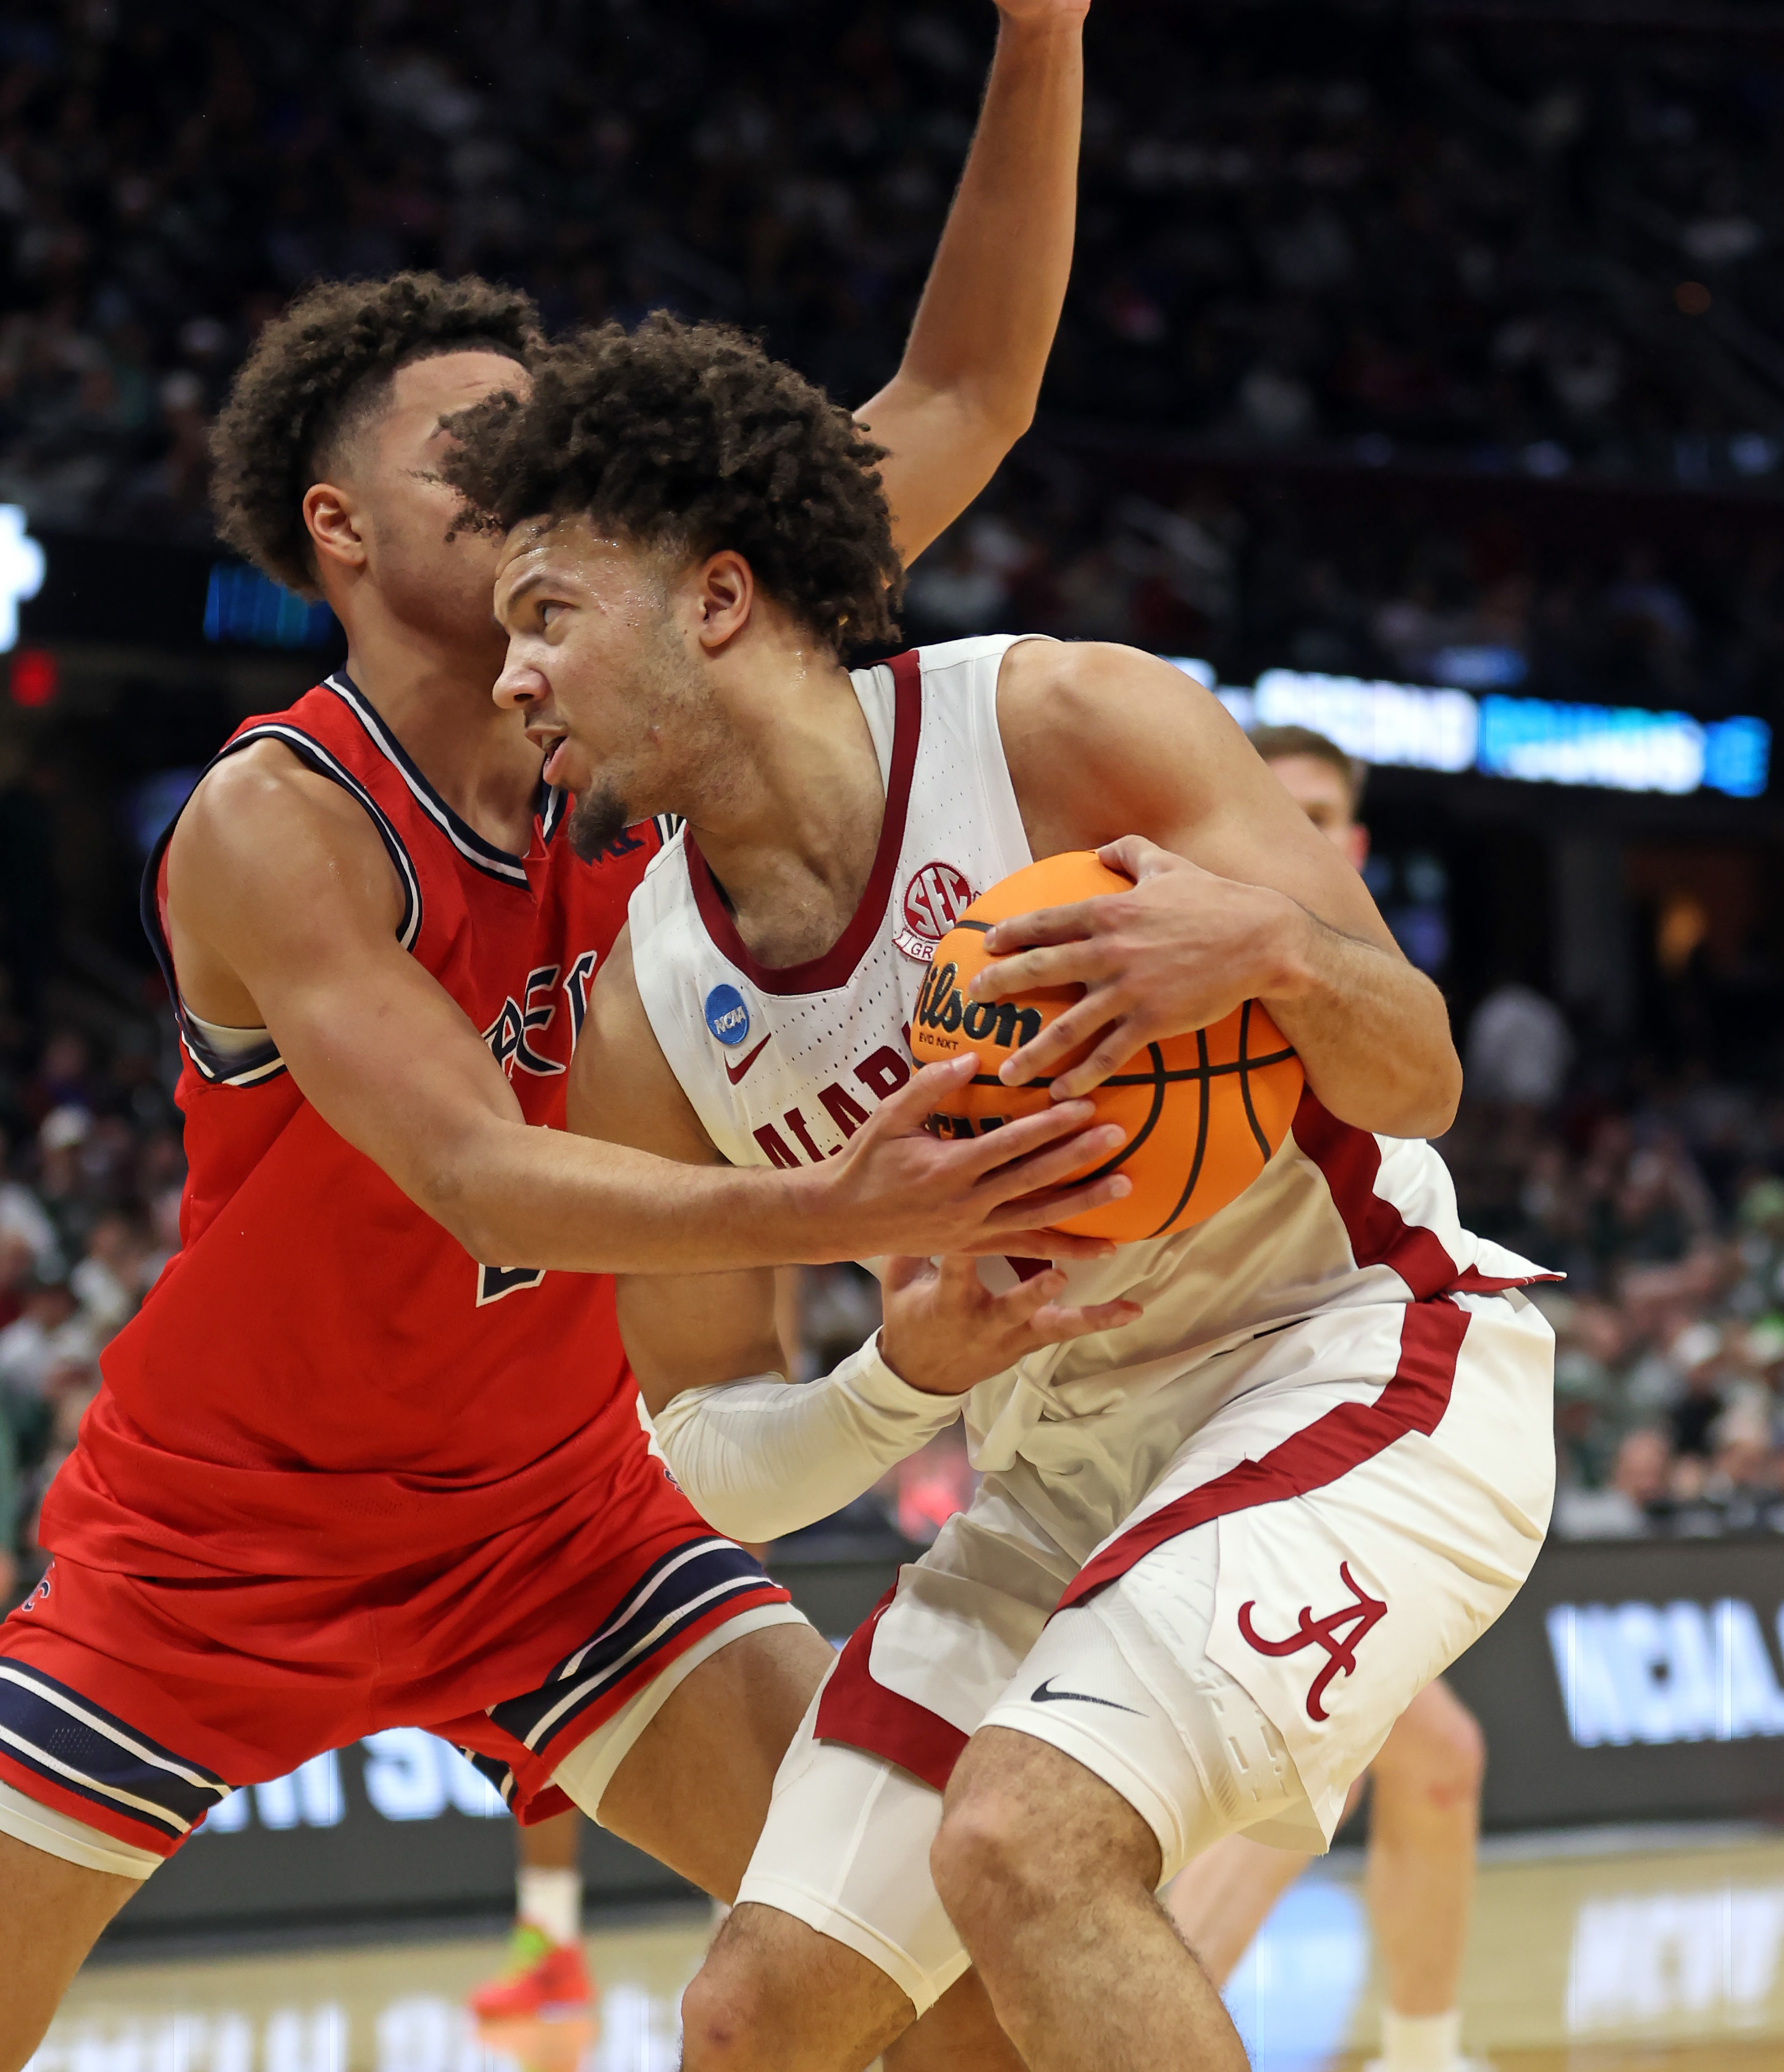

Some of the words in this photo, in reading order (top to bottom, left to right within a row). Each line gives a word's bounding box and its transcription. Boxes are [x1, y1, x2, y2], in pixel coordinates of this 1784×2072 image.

[907, 867, 968, 937] SEC
[911, 943, 935, 959] GR
[713, 1005, 747, 1035] NCAA
[913, 961, 1043, 1048] ilson
[919, 1032, 934, 1043] EVO
[936, 1037, 959, 1050] NXT
[1237, 1560, 1387, 1722] A
